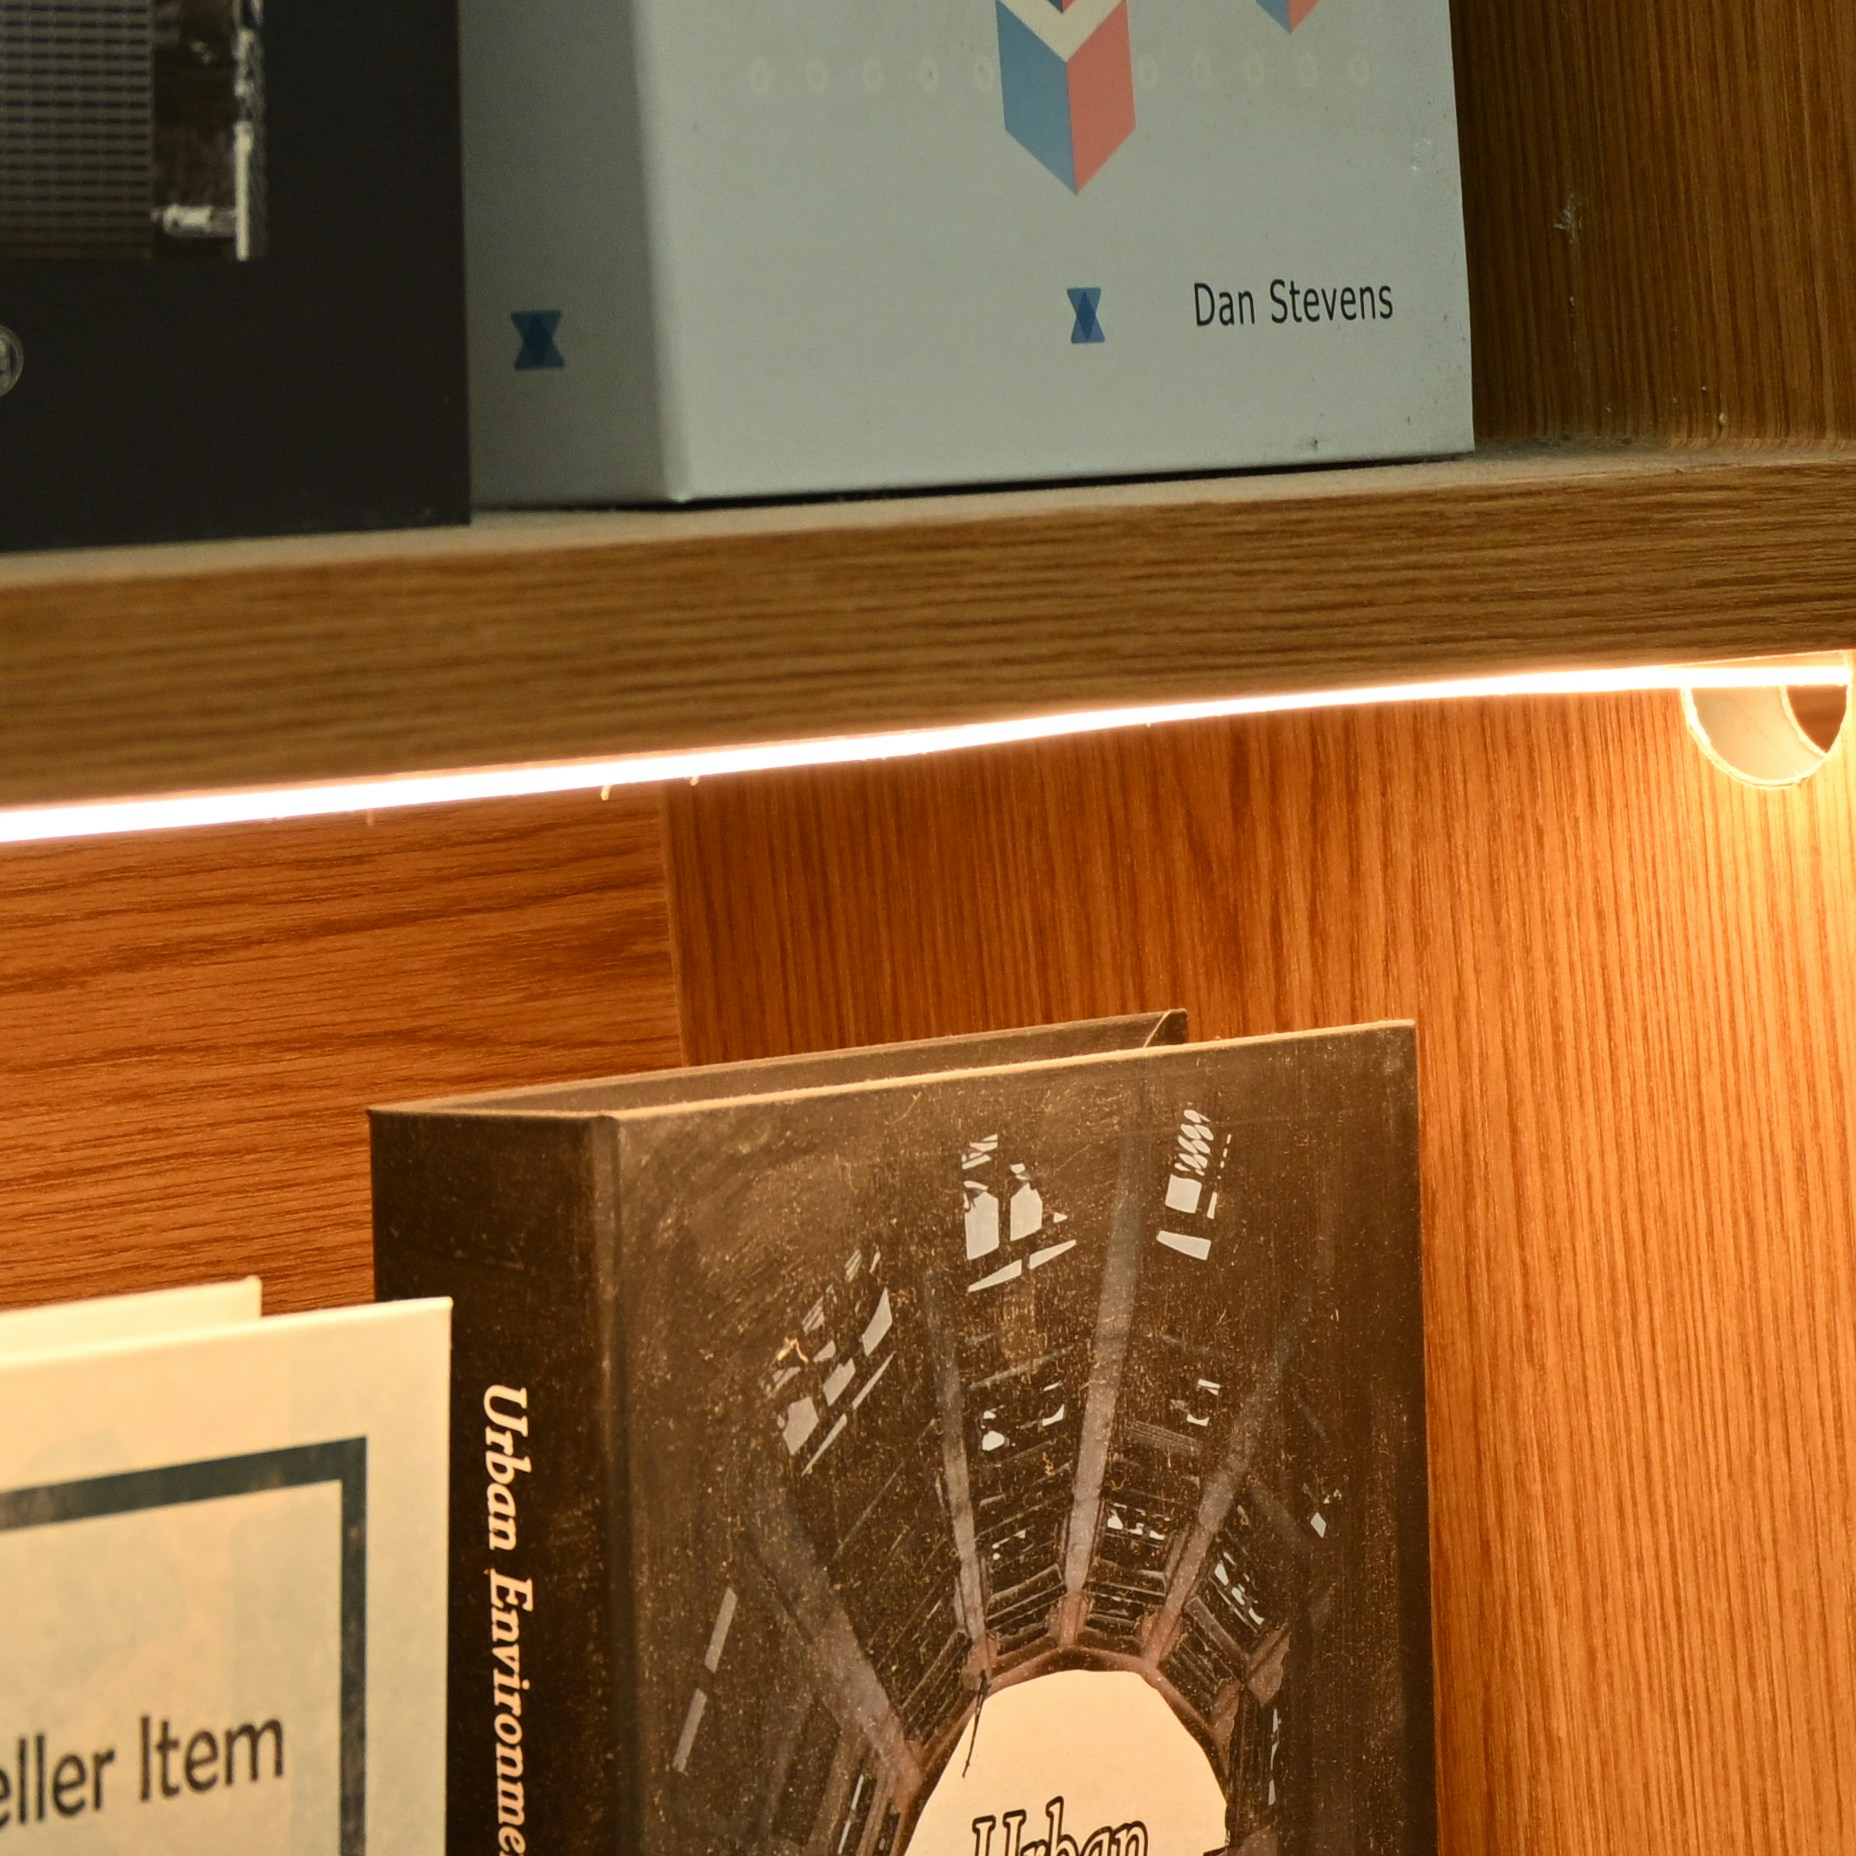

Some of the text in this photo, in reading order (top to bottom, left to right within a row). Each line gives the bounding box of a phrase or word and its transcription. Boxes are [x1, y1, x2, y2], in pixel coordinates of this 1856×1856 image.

[1193, 279, 1394, 326] Dan Stevens
[484, 1384, 530, 1550] Urban
[140, 1716, 283, 1801] Item
